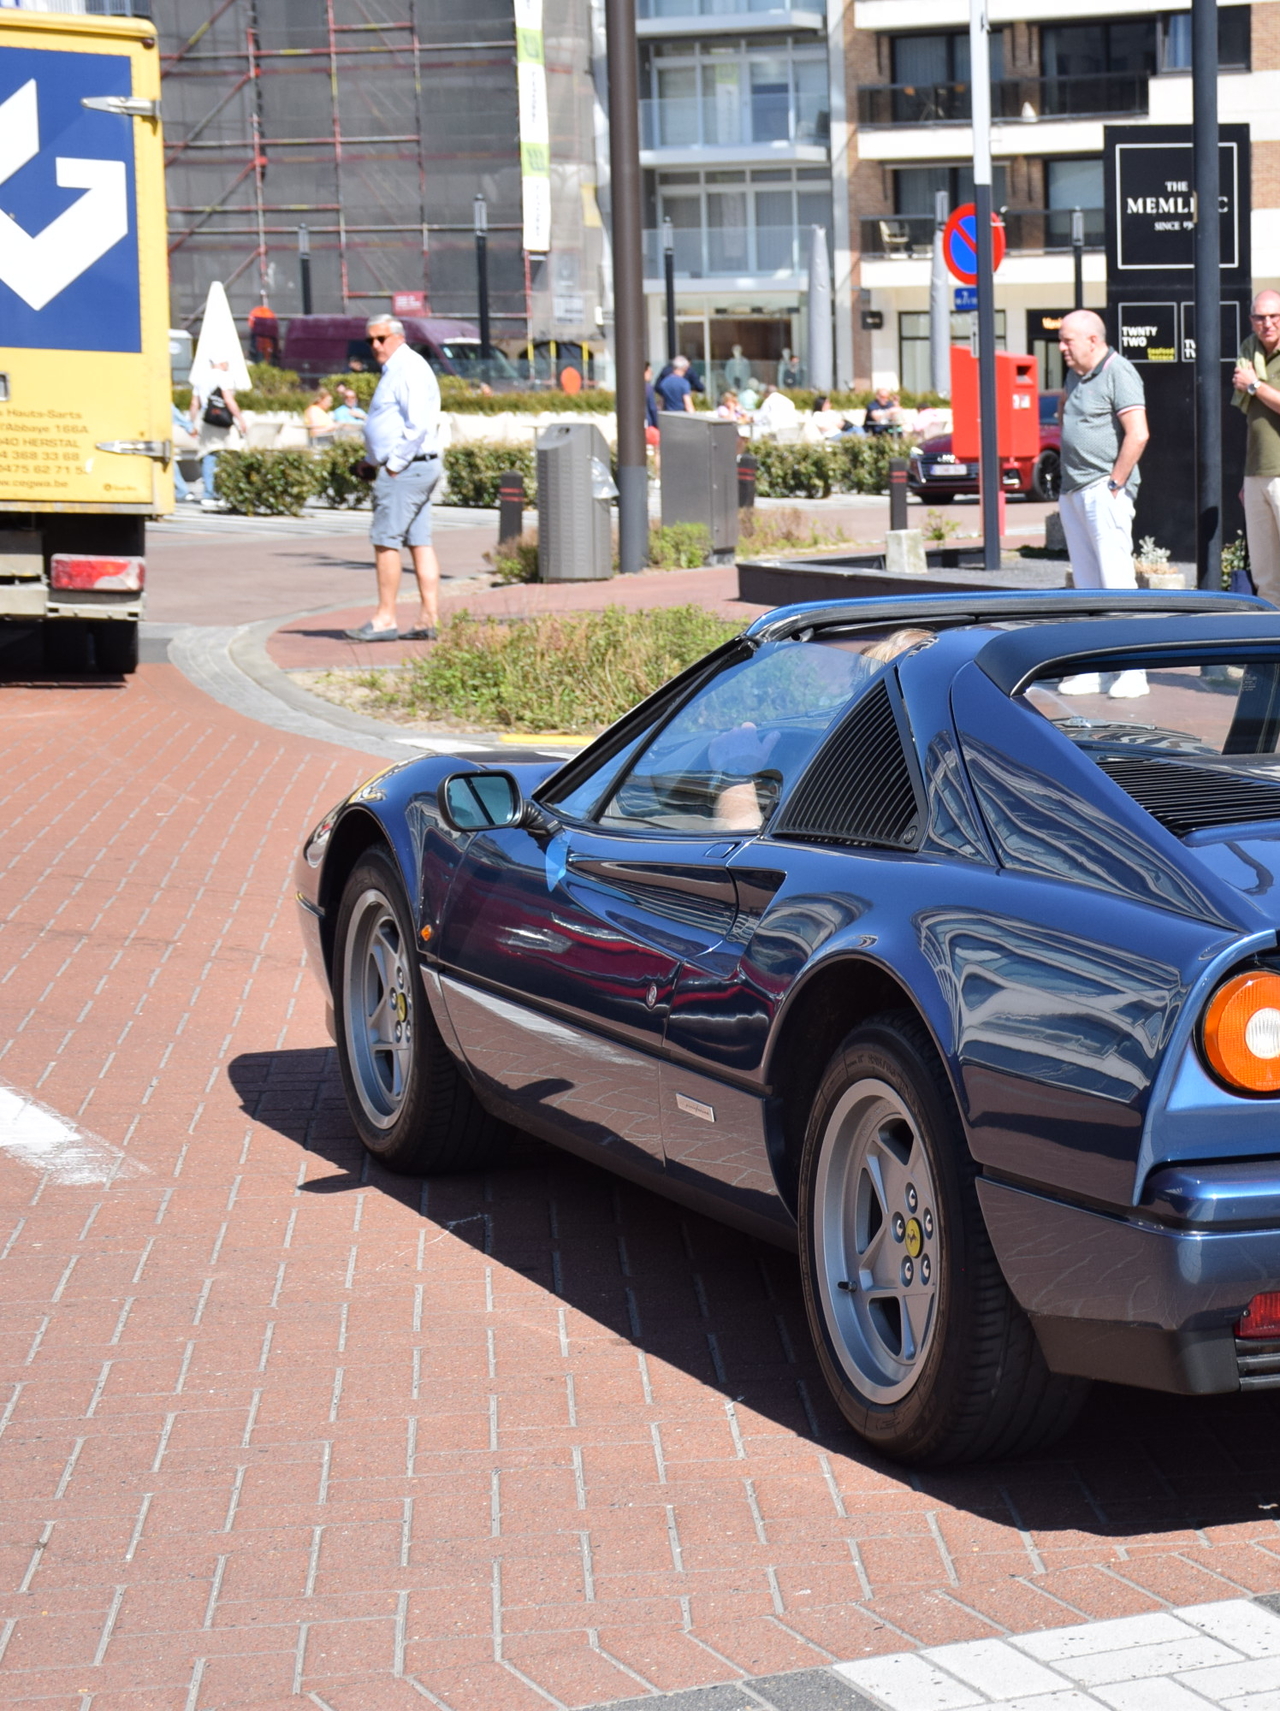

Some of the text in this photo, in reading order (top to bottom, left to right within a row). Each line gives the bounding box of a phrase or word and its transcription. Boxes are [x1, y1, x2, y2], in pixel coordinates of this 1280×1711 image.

[1165, 180, 1188, 192] THE
[1126, 196, 1229, 214] MEMLIC
[1154, 221, 1180, 231] SINCE
[1122, 326, 1158, 337] TWNTY
[1122, 336, 1147, 347] TWO
[23, 437, 80, 449] HERSTAL
[42, 451, 59, 461] 33
